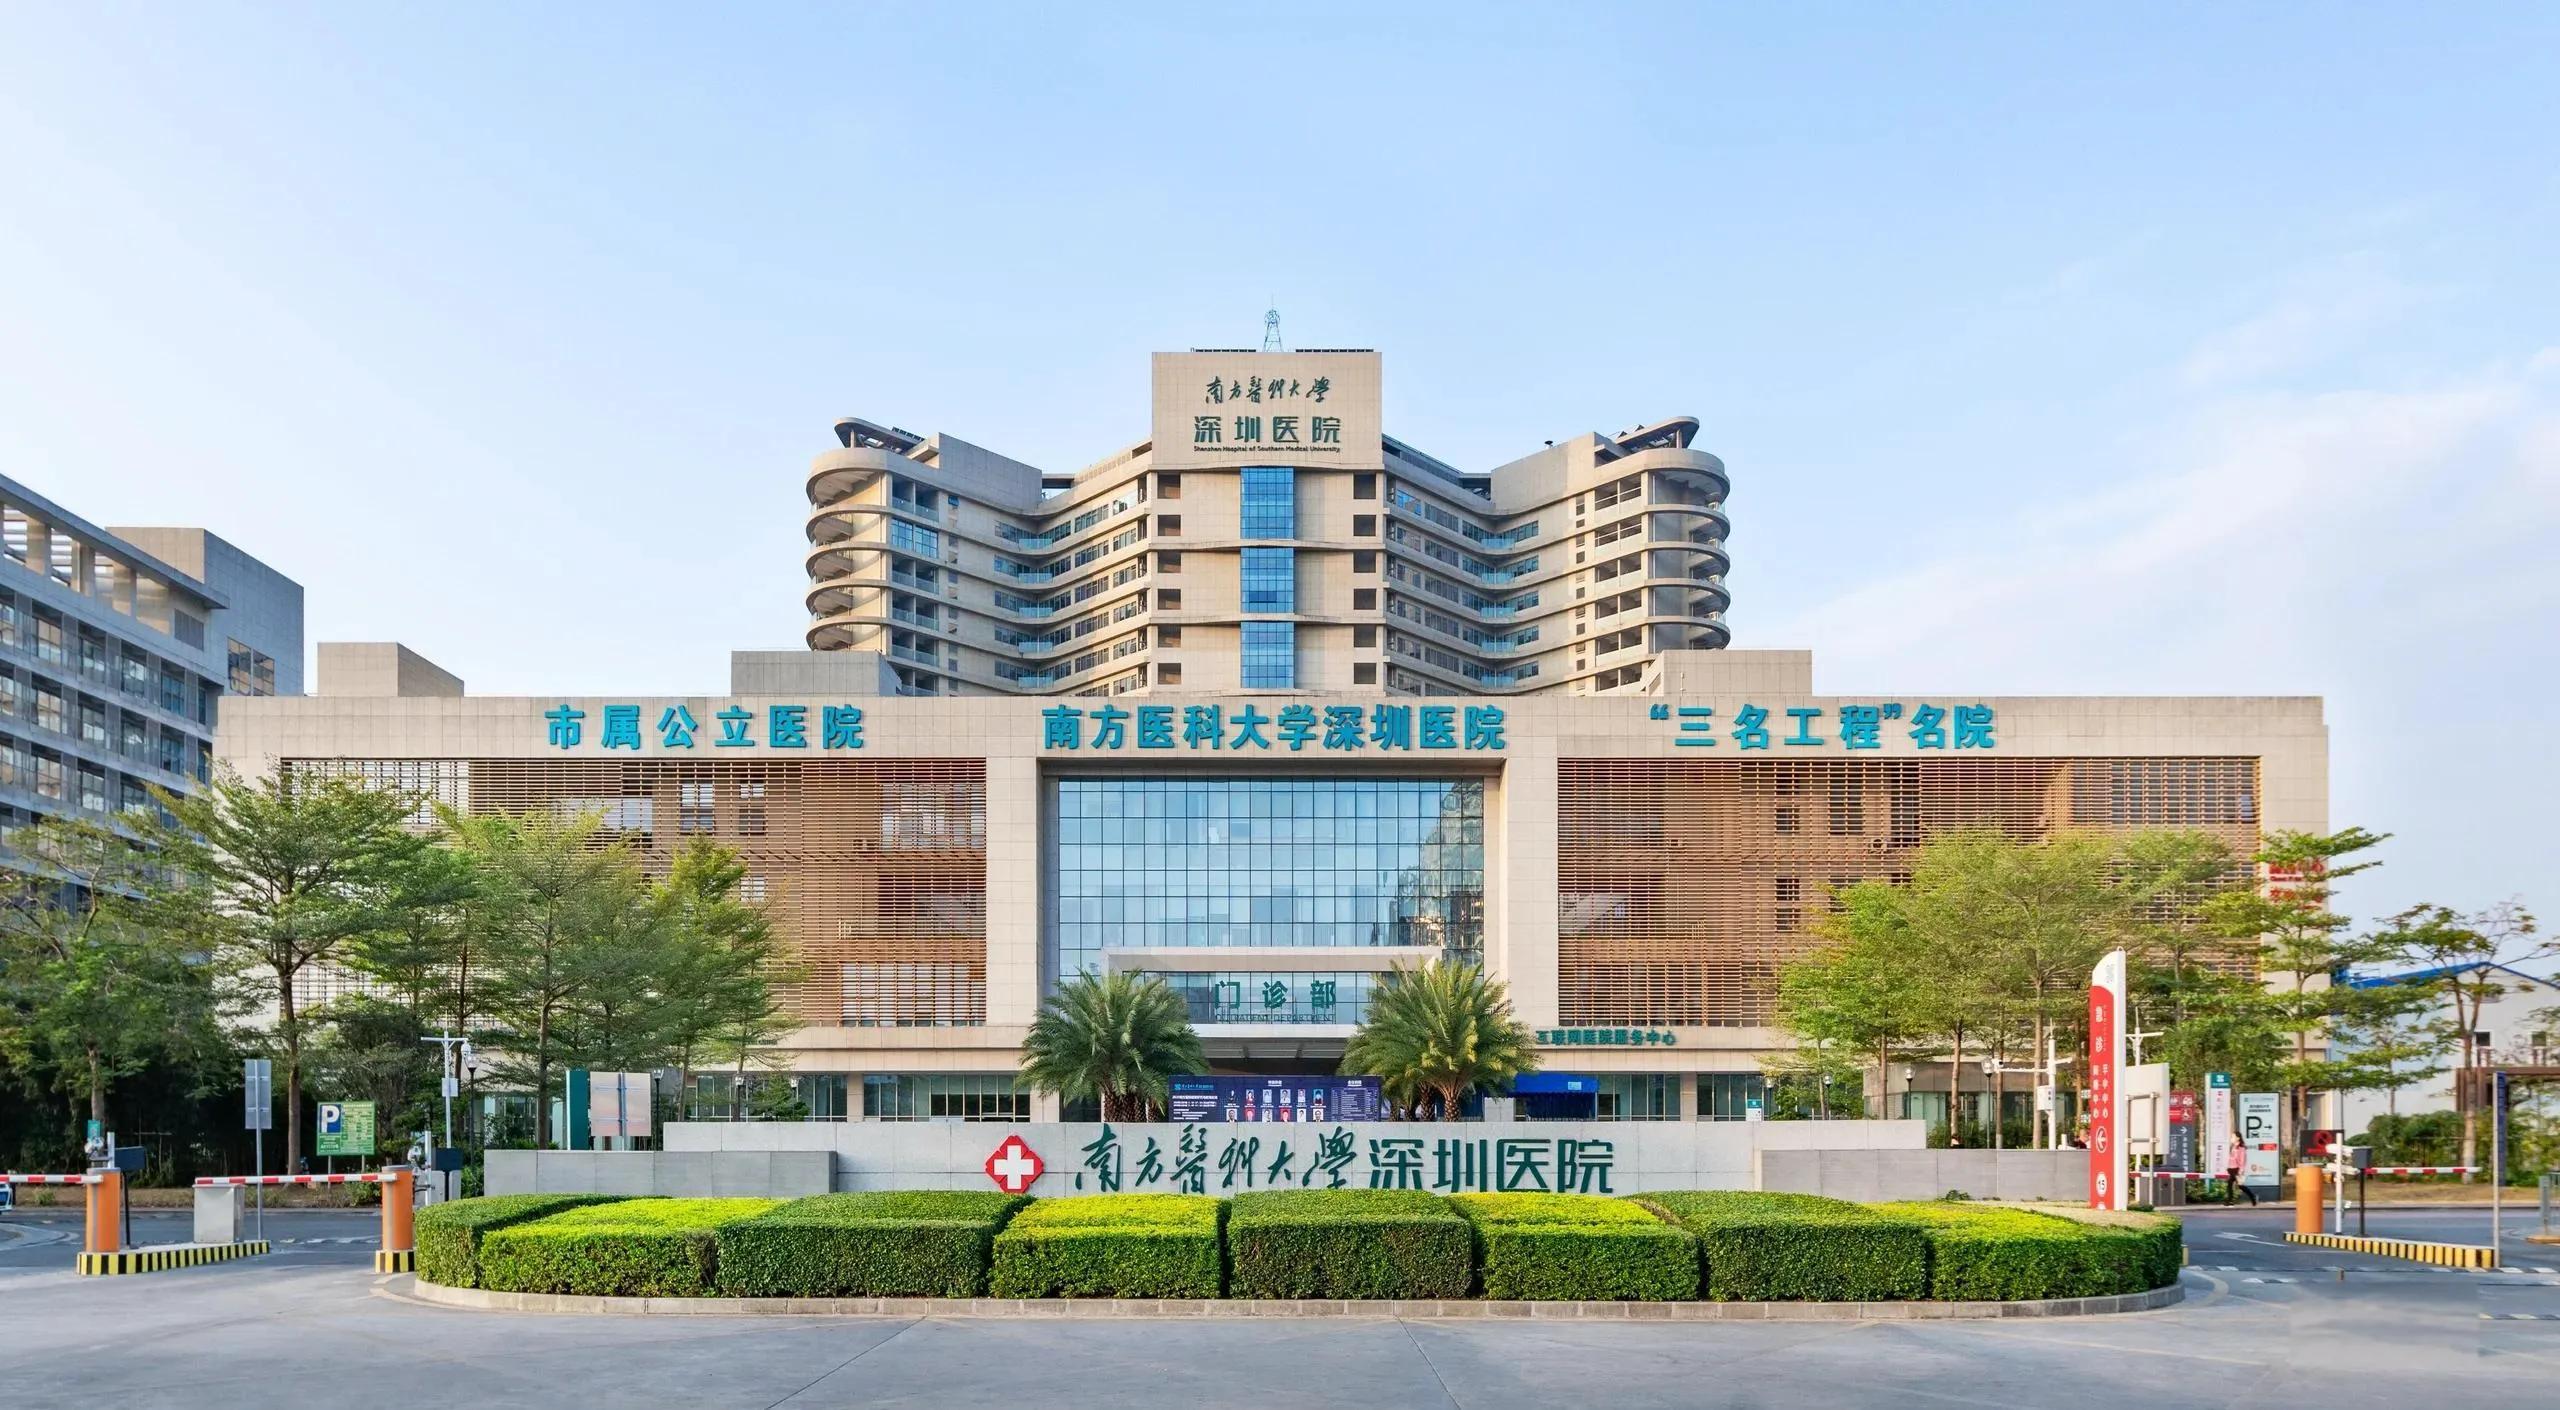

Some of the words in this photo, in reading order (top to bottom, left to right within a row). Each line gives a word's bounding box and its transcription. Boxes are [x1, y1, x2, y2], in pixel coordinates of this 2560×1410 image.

[1194, 416, 1341, 443] 深圳医院
[544, 704, 864, 750] 市属公立医院
[1041, 704, 1507, 751] 南方医科大学深圳医院
[1214, 980, 1337, 1009] 门诊部
[1535, 1028, 1677, 1046] 互联网医院服务中心
[321, 1105, 340, 1133] P
[2246, 1116, 2262, 1138] P
